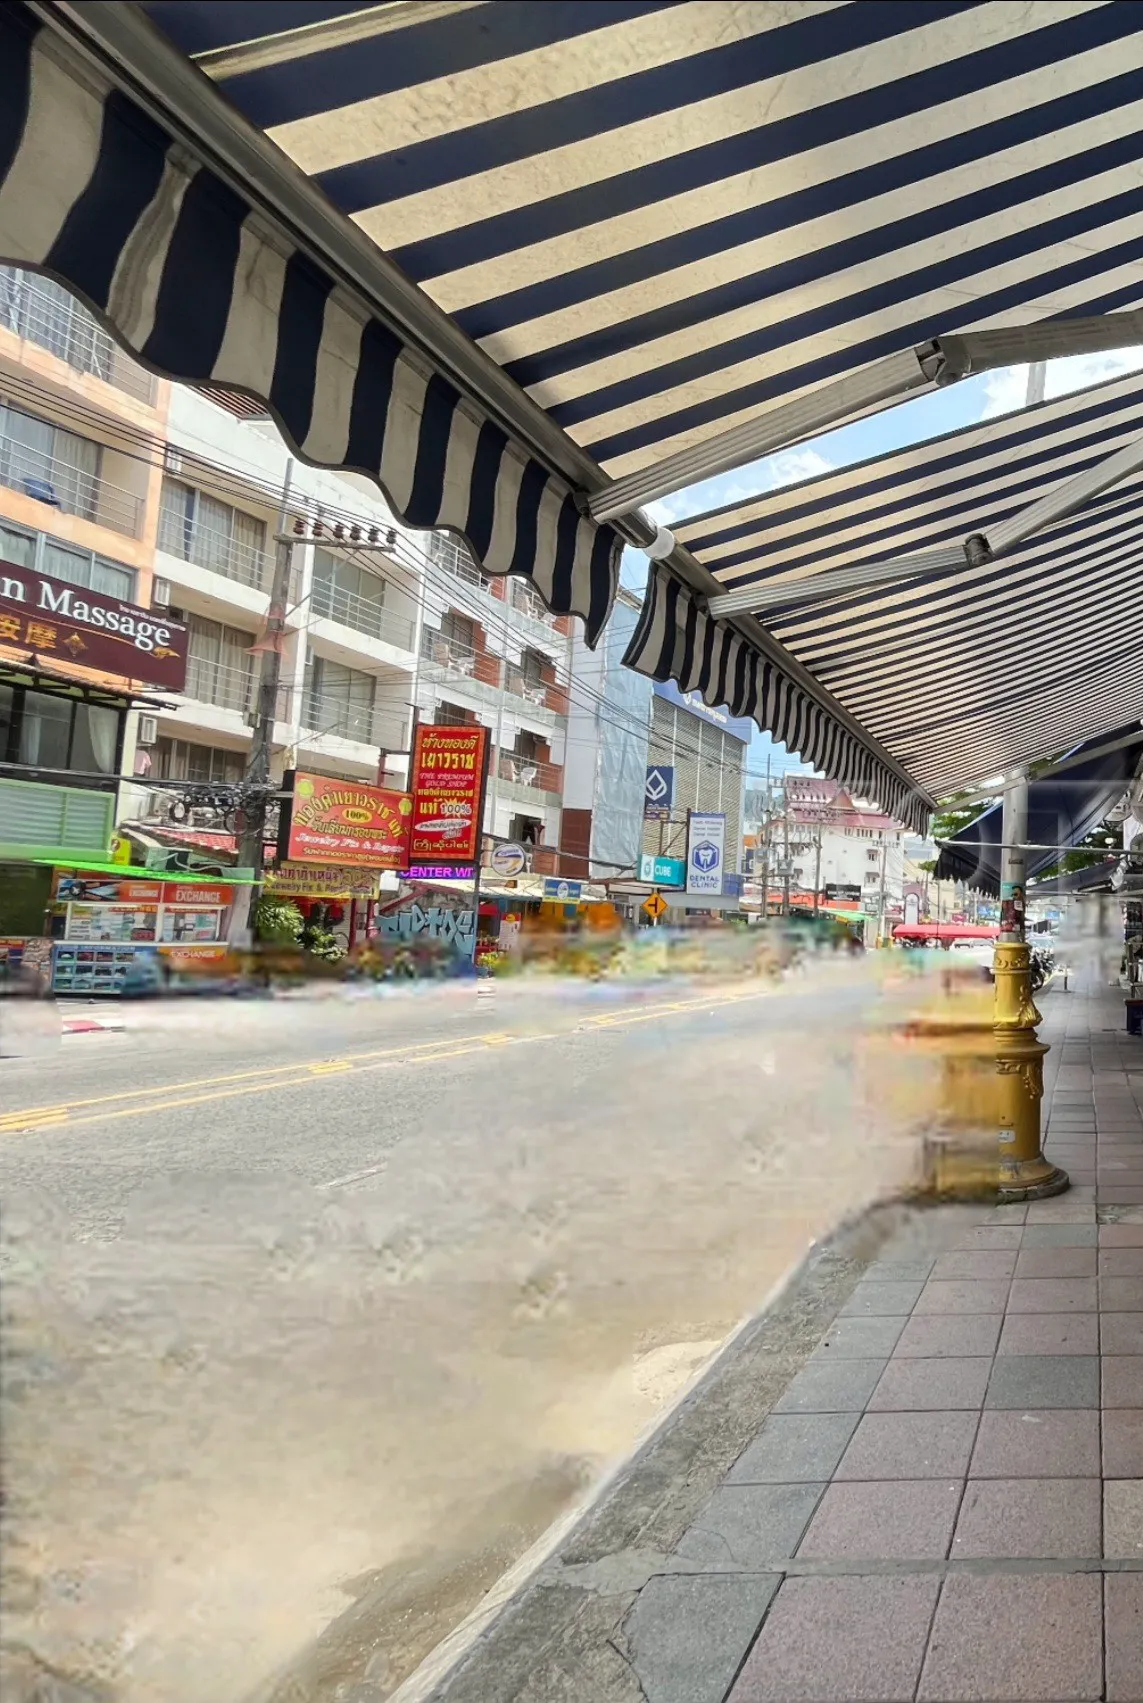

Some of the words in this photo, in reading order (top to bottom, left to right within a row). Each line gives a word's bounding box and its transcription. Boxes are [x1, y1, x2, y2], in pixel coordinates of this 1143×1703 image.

[37, 580, 171, 651] Massage
[441, 803, 472, 814] 100%
[345, 810, 369, 820] 100%
[362, 841, 372, 850] &
[655, 865, 672, 877] CUBE
[176, 890, 221, 903] EXCHANGE
